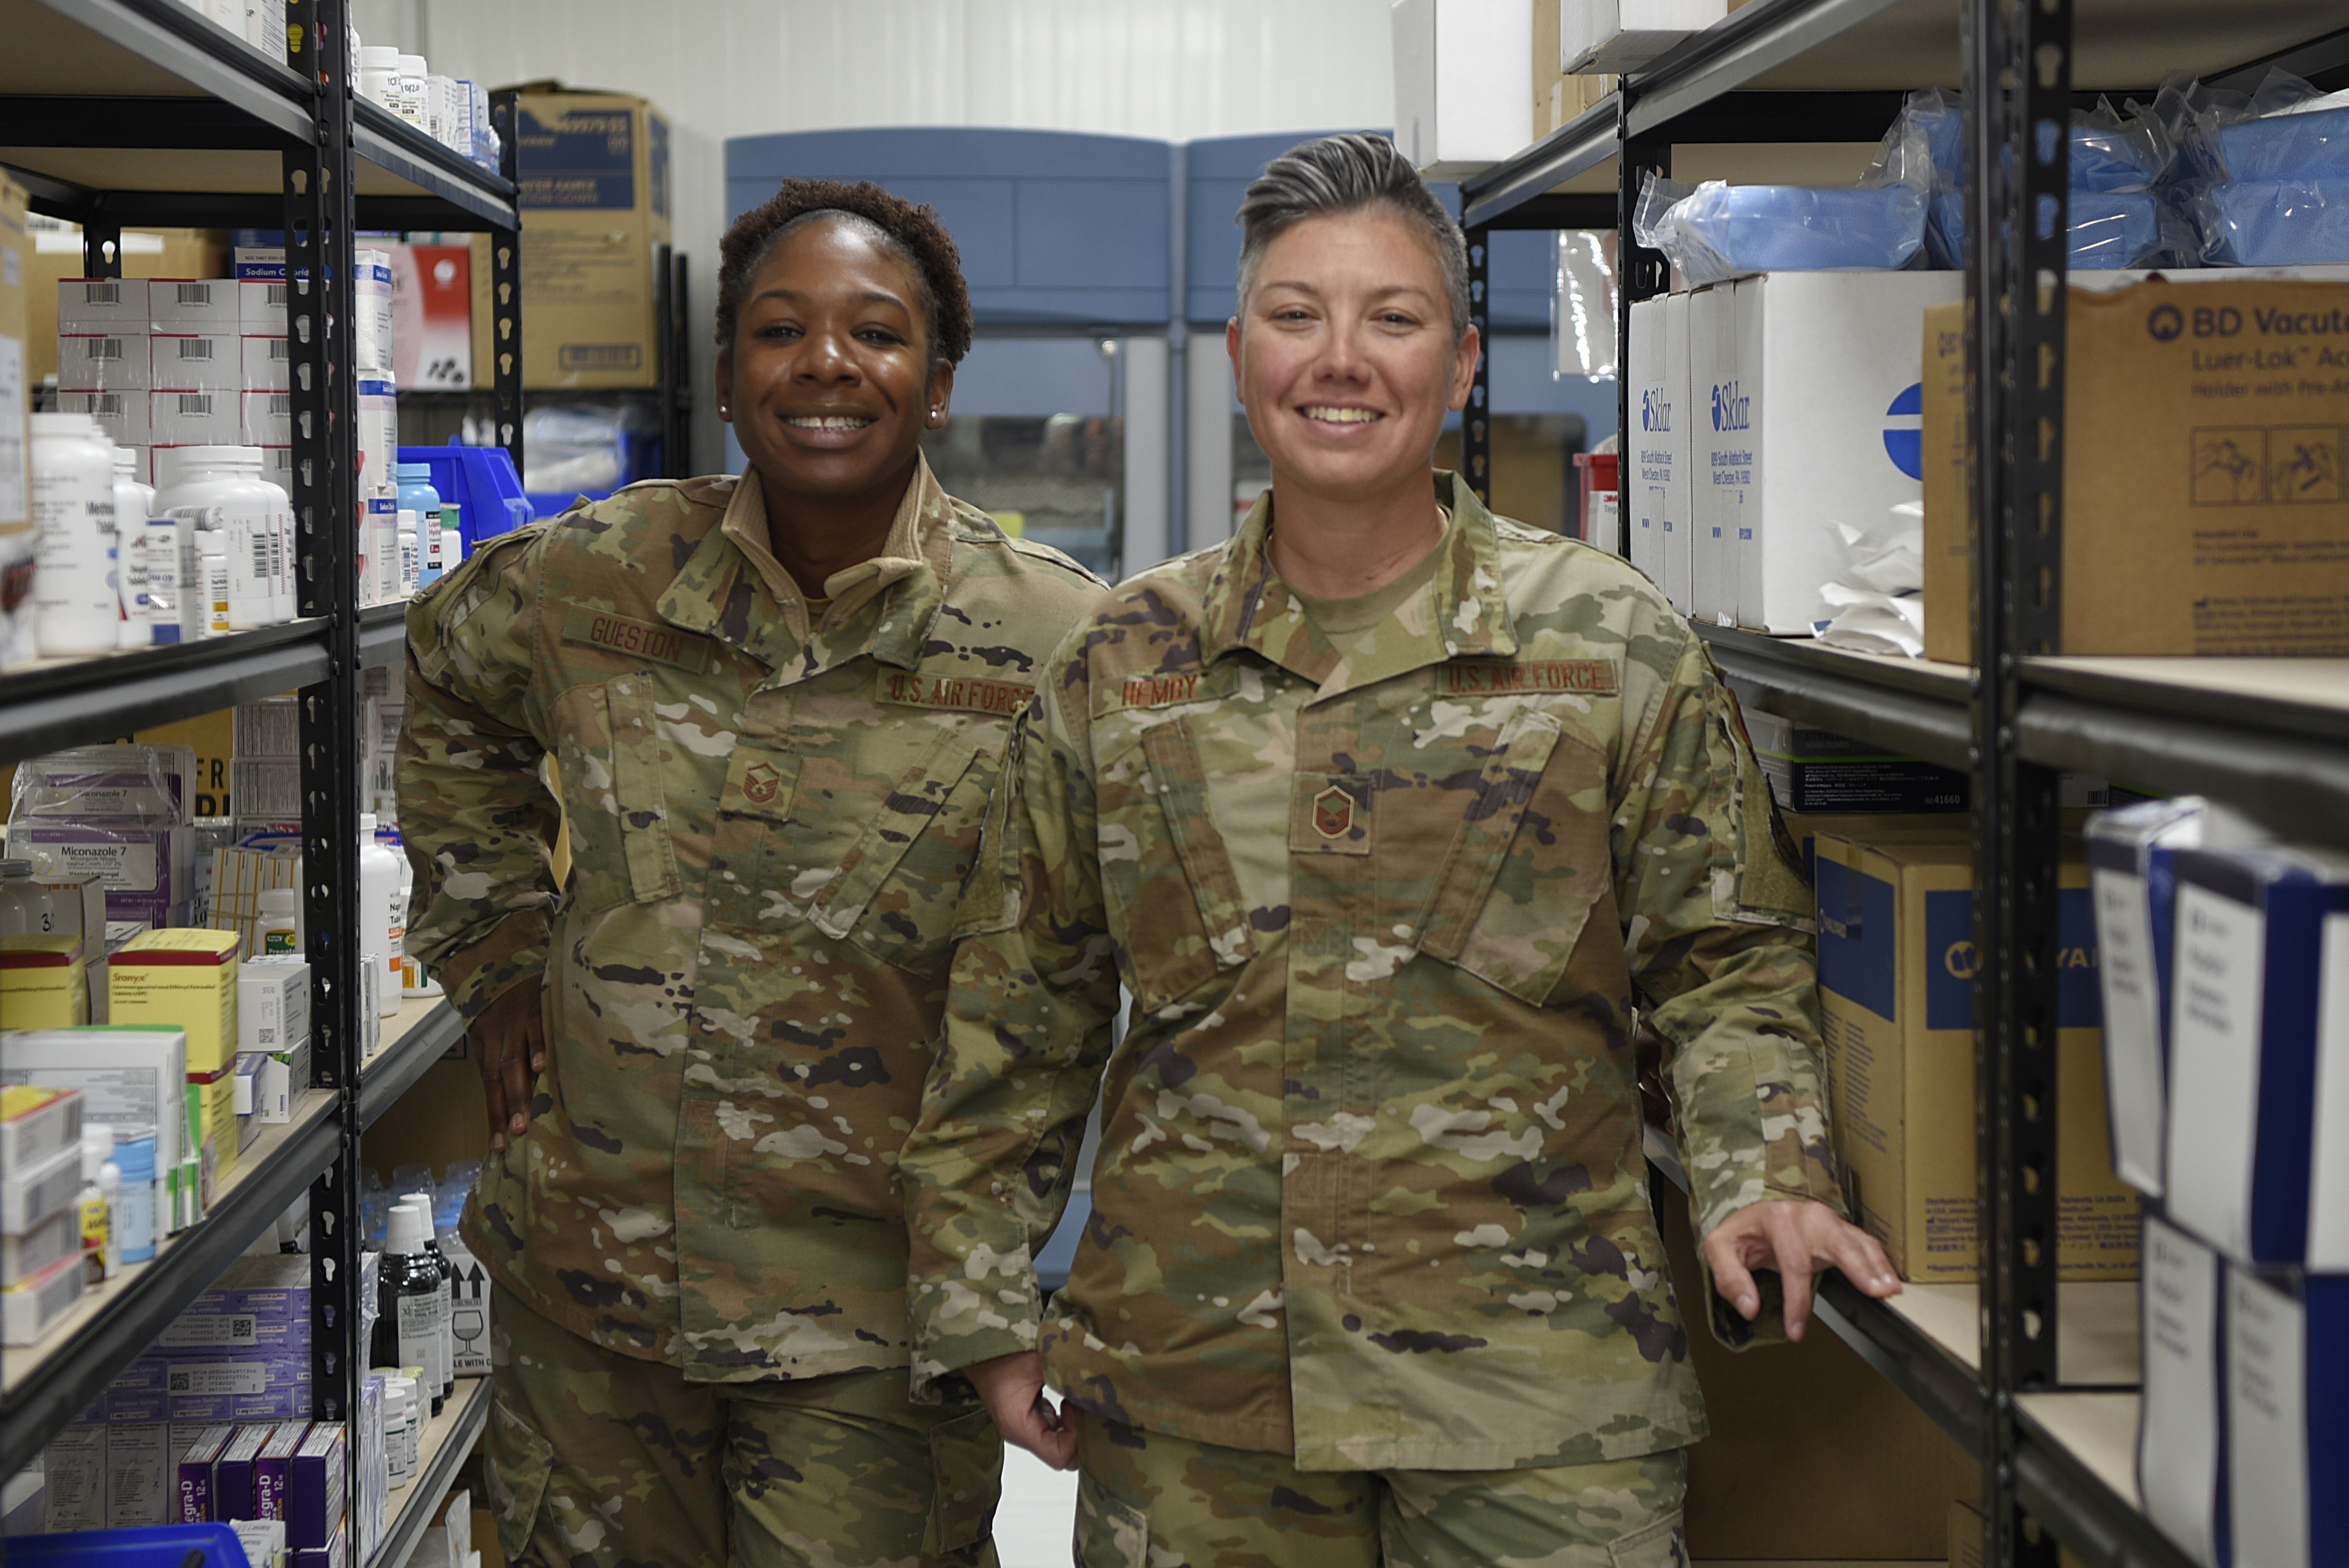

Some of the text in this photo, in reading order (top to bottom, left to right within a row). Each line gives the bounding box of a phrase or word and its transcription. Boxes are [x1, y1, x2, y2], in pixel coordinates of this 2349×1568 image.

[401, 84, 420, 93] 10/20
[2193, 306, 2349, 338] BD Vacut
[1649, 387, 1671, 432] Sklar
[1721, 380, 1750, 431] Sklar
[1604, 495, 1618, 503] 3M
[591, 617, 684, 661] GUESTON
[1449, 663, 1605, 692] U.S. AIR FORCE
[891, 674, 925, 703] U.S.
[929, 679, 963, 706] AIR
[1122, 674, 1198, 706] HEMBY
[1934, 795, 1960, 804] 41660
[61, 846, 127, 856] Miconazole 7
[464, 1358, 484, 1367] WITH
[196, 1485, 206, 1497] 12
[274, 1480, 284, 1491] 12
